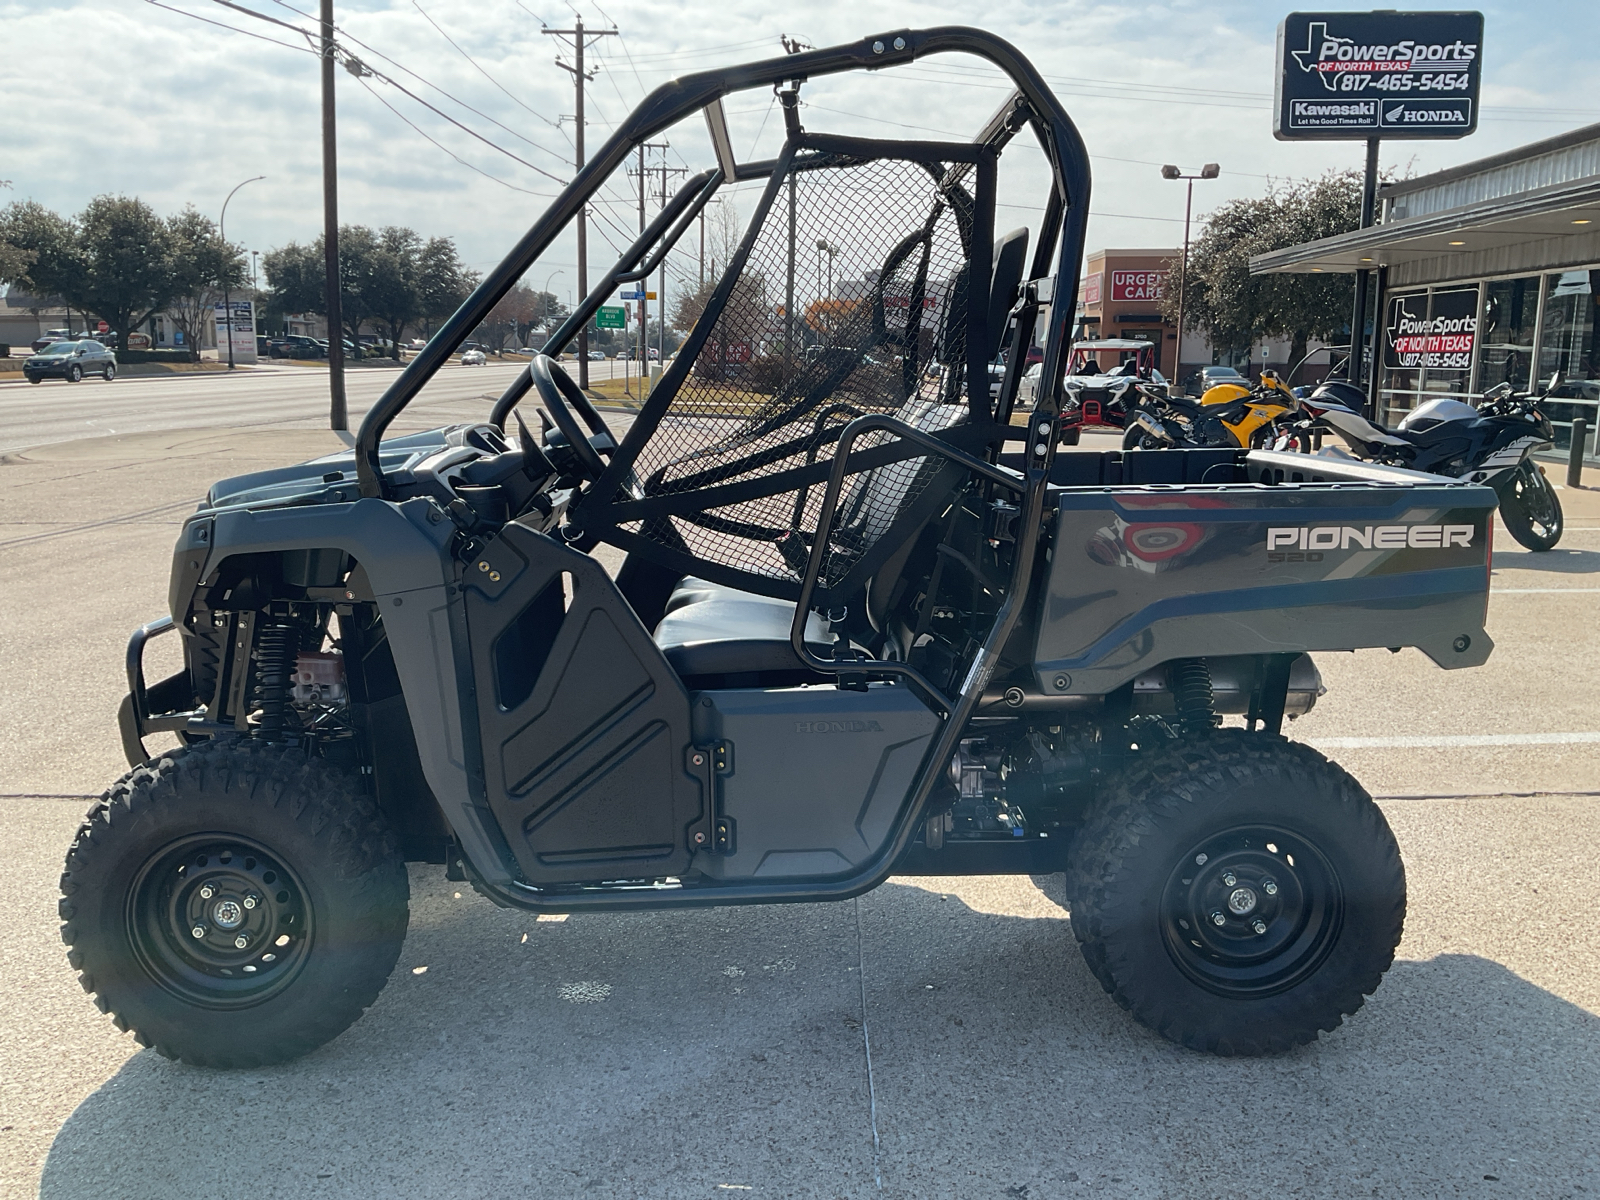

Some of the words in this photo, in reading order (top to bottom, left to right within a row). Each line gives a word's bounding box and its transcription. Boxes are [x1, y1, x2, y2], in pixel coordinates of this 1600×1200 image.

[1319, 41, 1477, 64] PowerSports
[1318, 62, 1334, 71] OF
[1334, 62, 1371, 71] NORTH
[1374, 61, 1409, 71] TEXAS
[1341, 73, 1469, 91] 817-465-5454
[1295, 102, 1375, 115] Kawasaki
[1403, 110, 1465, 122] HONDA
[1115, 274, 1162, 286] URGE
[1398, 315, 1477, 335] PowerSports
[1396, 338, 1409, 351] OF
[1441, 336, 1472, 350] TEXAS
[1267, 525, 1475, 550] PIONEER
[1268, 552, 1324, 563] 520
[794, 720, 884, 734] HONDA
